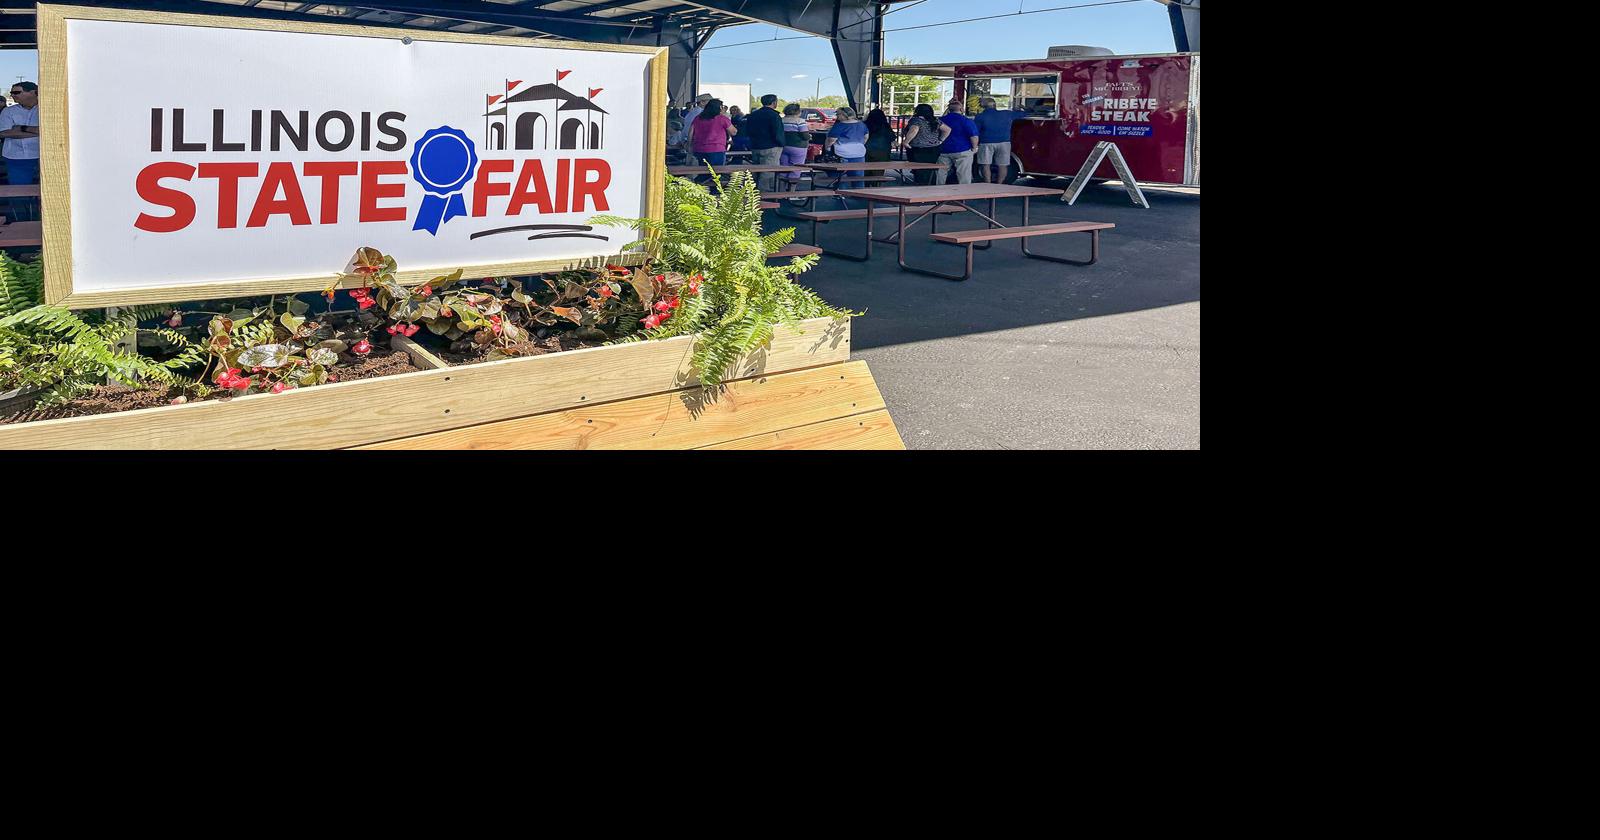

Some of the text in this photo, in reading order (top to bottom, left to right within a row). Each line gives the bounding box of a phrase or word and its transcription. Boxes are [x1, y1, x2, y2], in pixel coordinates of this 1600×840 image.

[1091, 110, 1151, 122] STEAK
[1103, 98, 1157, 110] RIBEYE
[151, 108, 408, 152] ILLINOIS
[134, 158, 612, 233] STATE FAIR
